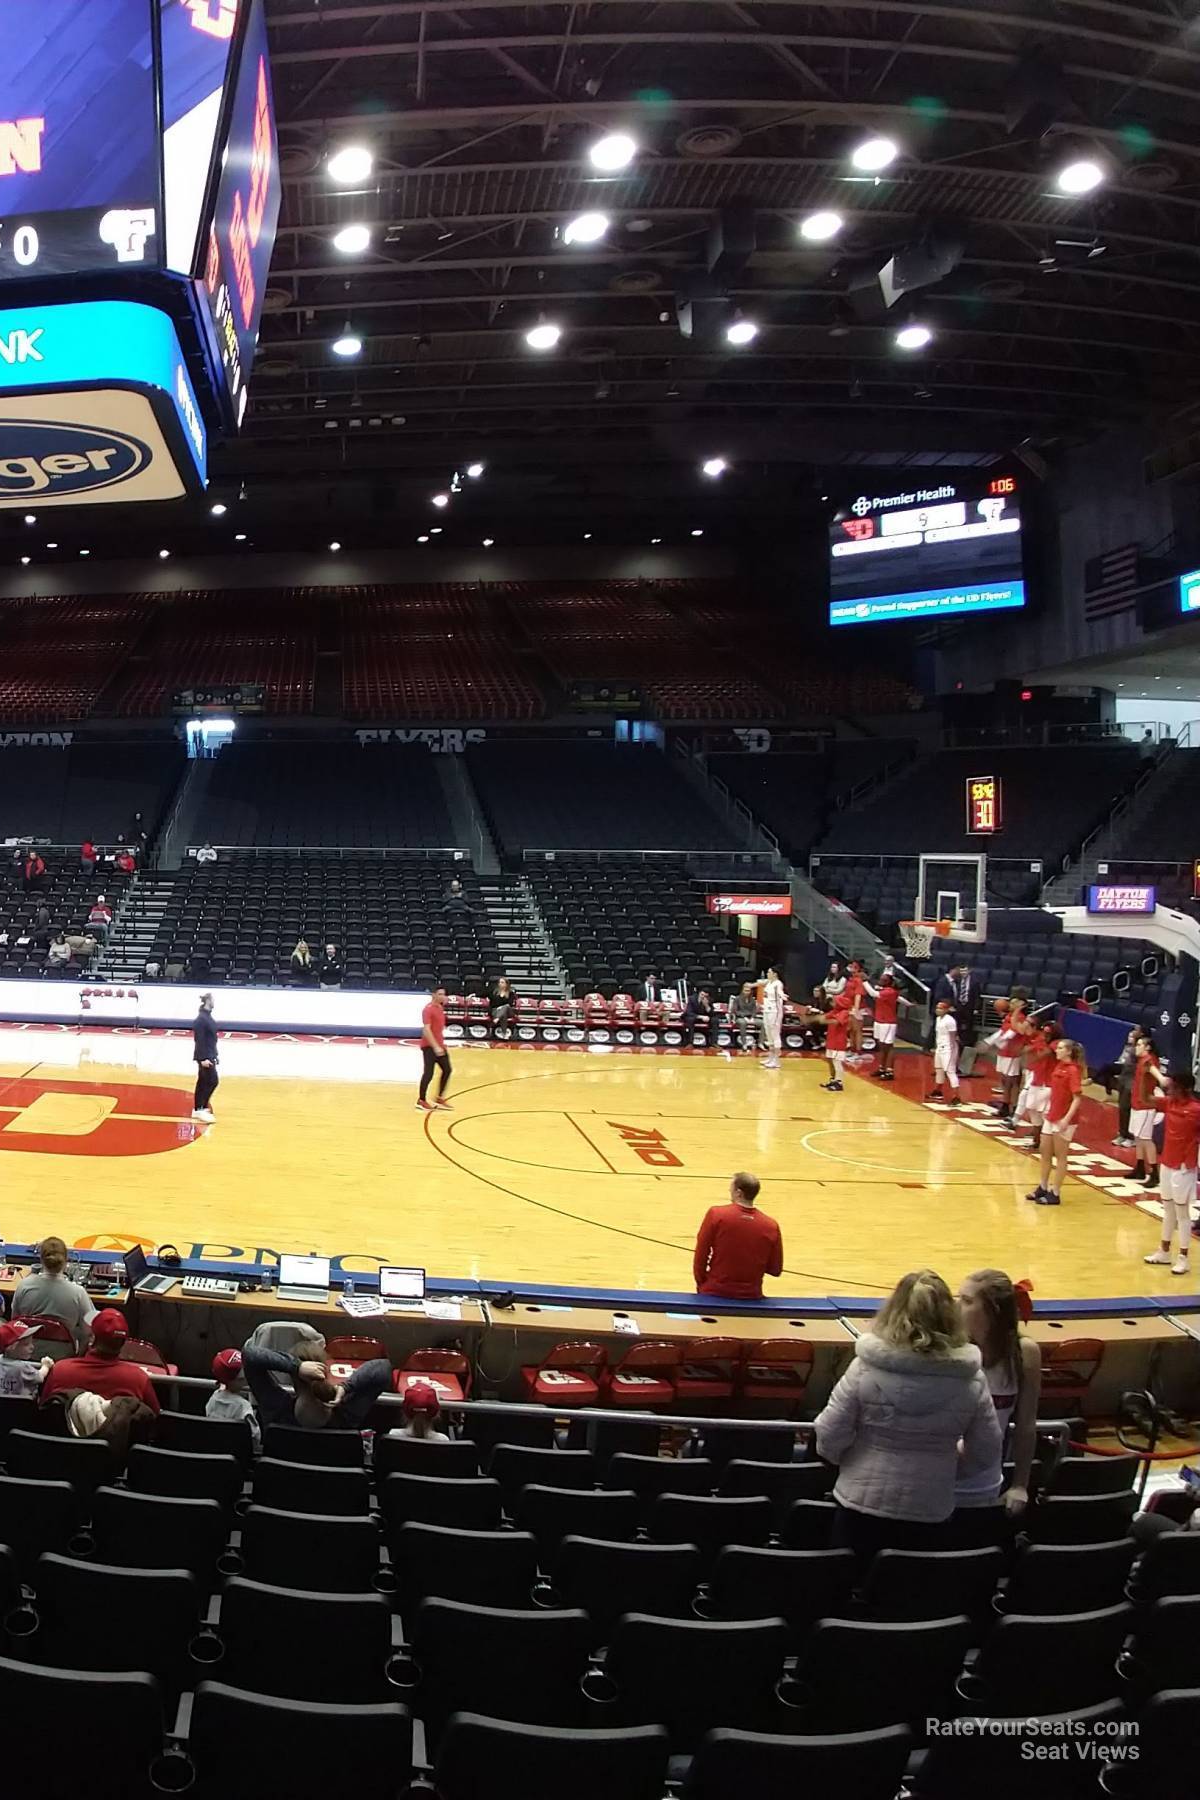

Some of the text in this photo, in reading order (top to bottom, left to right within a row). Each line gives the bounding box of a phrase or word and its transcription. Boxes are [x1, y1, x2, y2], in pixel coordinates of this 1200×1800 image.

[13, 226, 39, 266] 0
[872, 485, 955, 509] Premier Health
[1097, 887, 1150, 899] DAYTON
[1099, 899, 1146, 909] FLYERS
